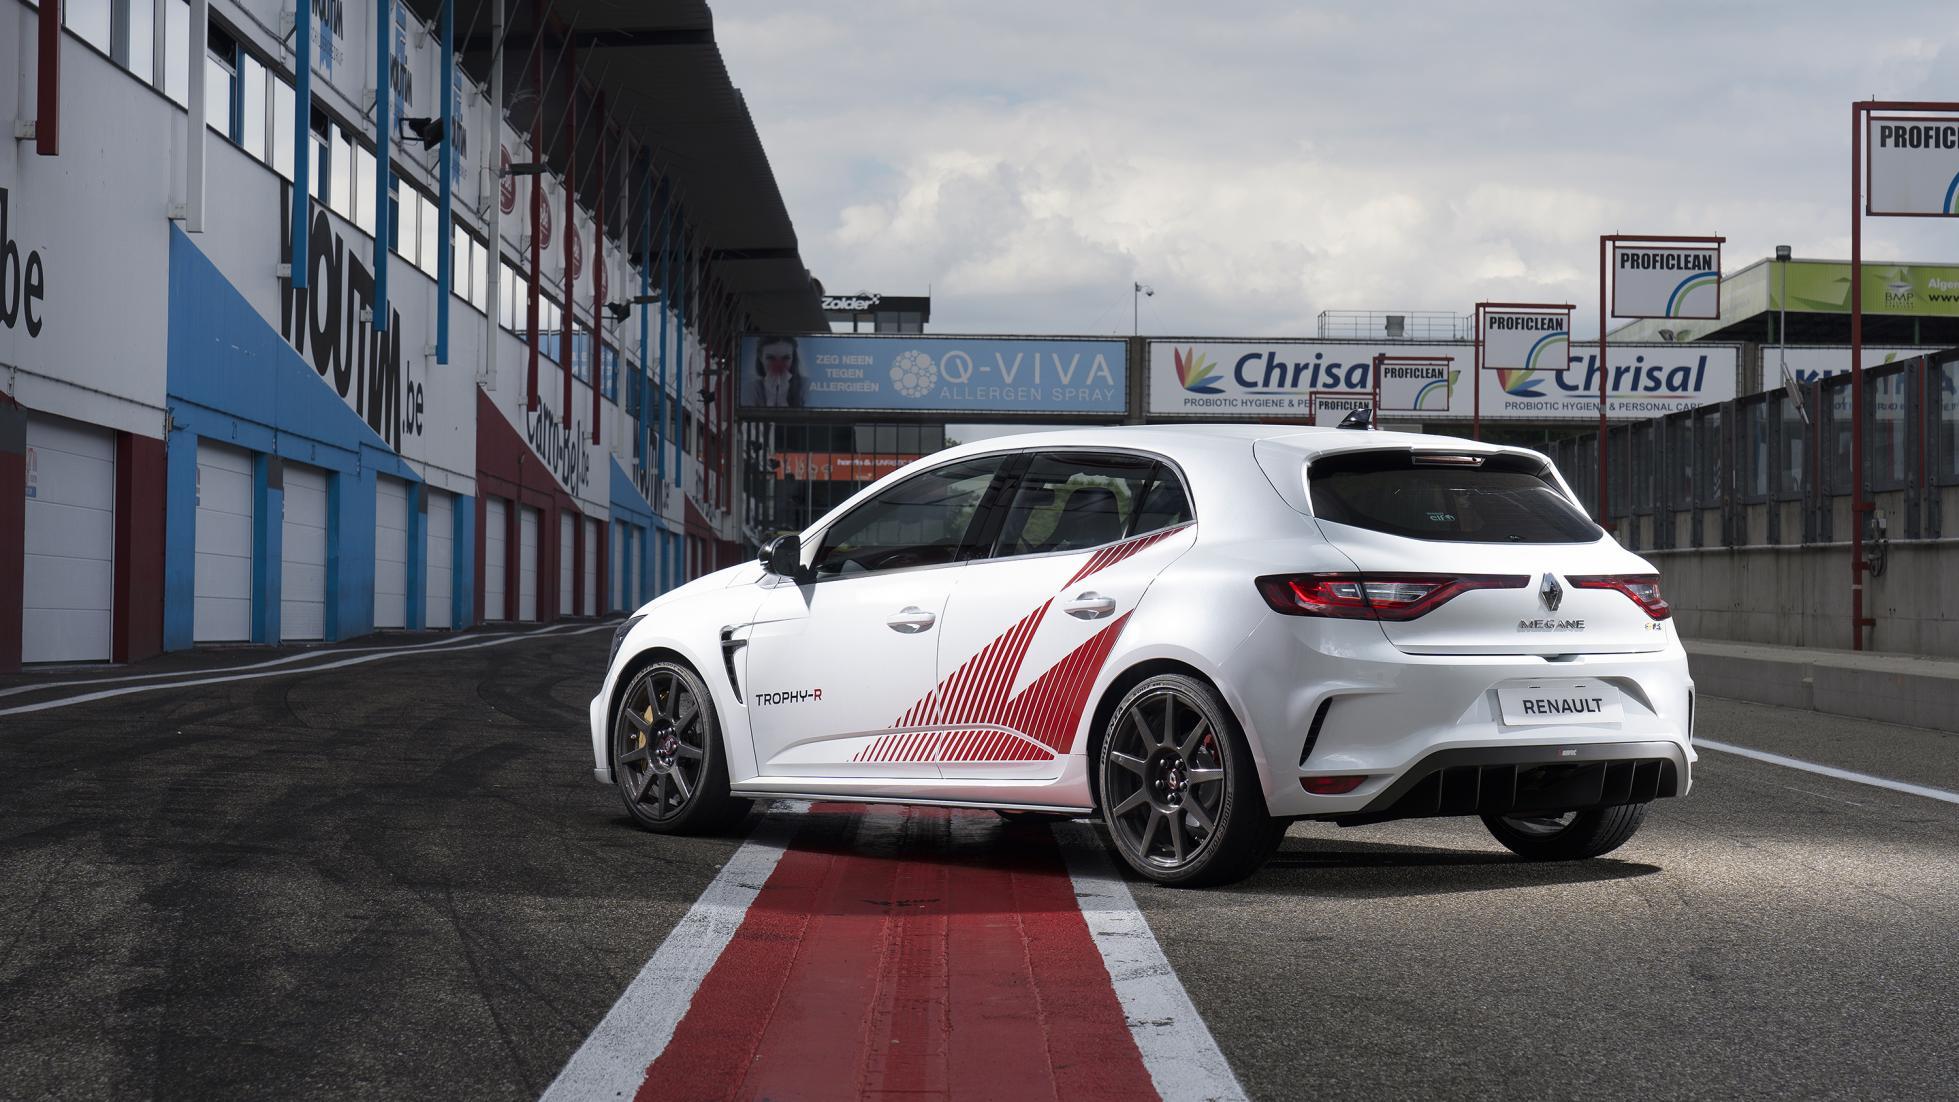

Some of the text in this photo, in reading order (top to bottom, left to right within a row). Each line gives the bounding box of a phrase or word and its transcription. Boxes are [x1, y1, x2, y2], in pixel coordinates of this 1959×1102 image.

[1620, 253, 1712, 271] PROFICLEAN
[822, 297, 873, 310] Zolder
[1489, 316, 1563, 331] PROFICLEAN
[816, 354, 874, 365] ZEG NEEN
[825, 368, 864, 378] TEGEN
[940, 350, 1115, 385] Q-VIVA
[1234, 351, 1371, 390] Chrisa
[1383, 366, 1444, 380] PROFICLEAN
[939, 387, 1115, 401] ALLERGEN SPRAY
[1183, 398, 1239, 408] PROBIOTIC
[1241, 399, 1285, 409] HYGIENE
[1287, 399, 1296, 409] &
[1504, 401, 1559, 411] PROBIOTIC
[1561, 402, 1601, 412] HYGIEN
[1608, 402, 1616, 411] &
[1618, 402, 1672, 412] PERSONAL
[1519, 619, 1586, 630] MEGANE
[755, 688, 823, 706] TROPHY-R
[1522, 698, 1603, 715] RENAULT
